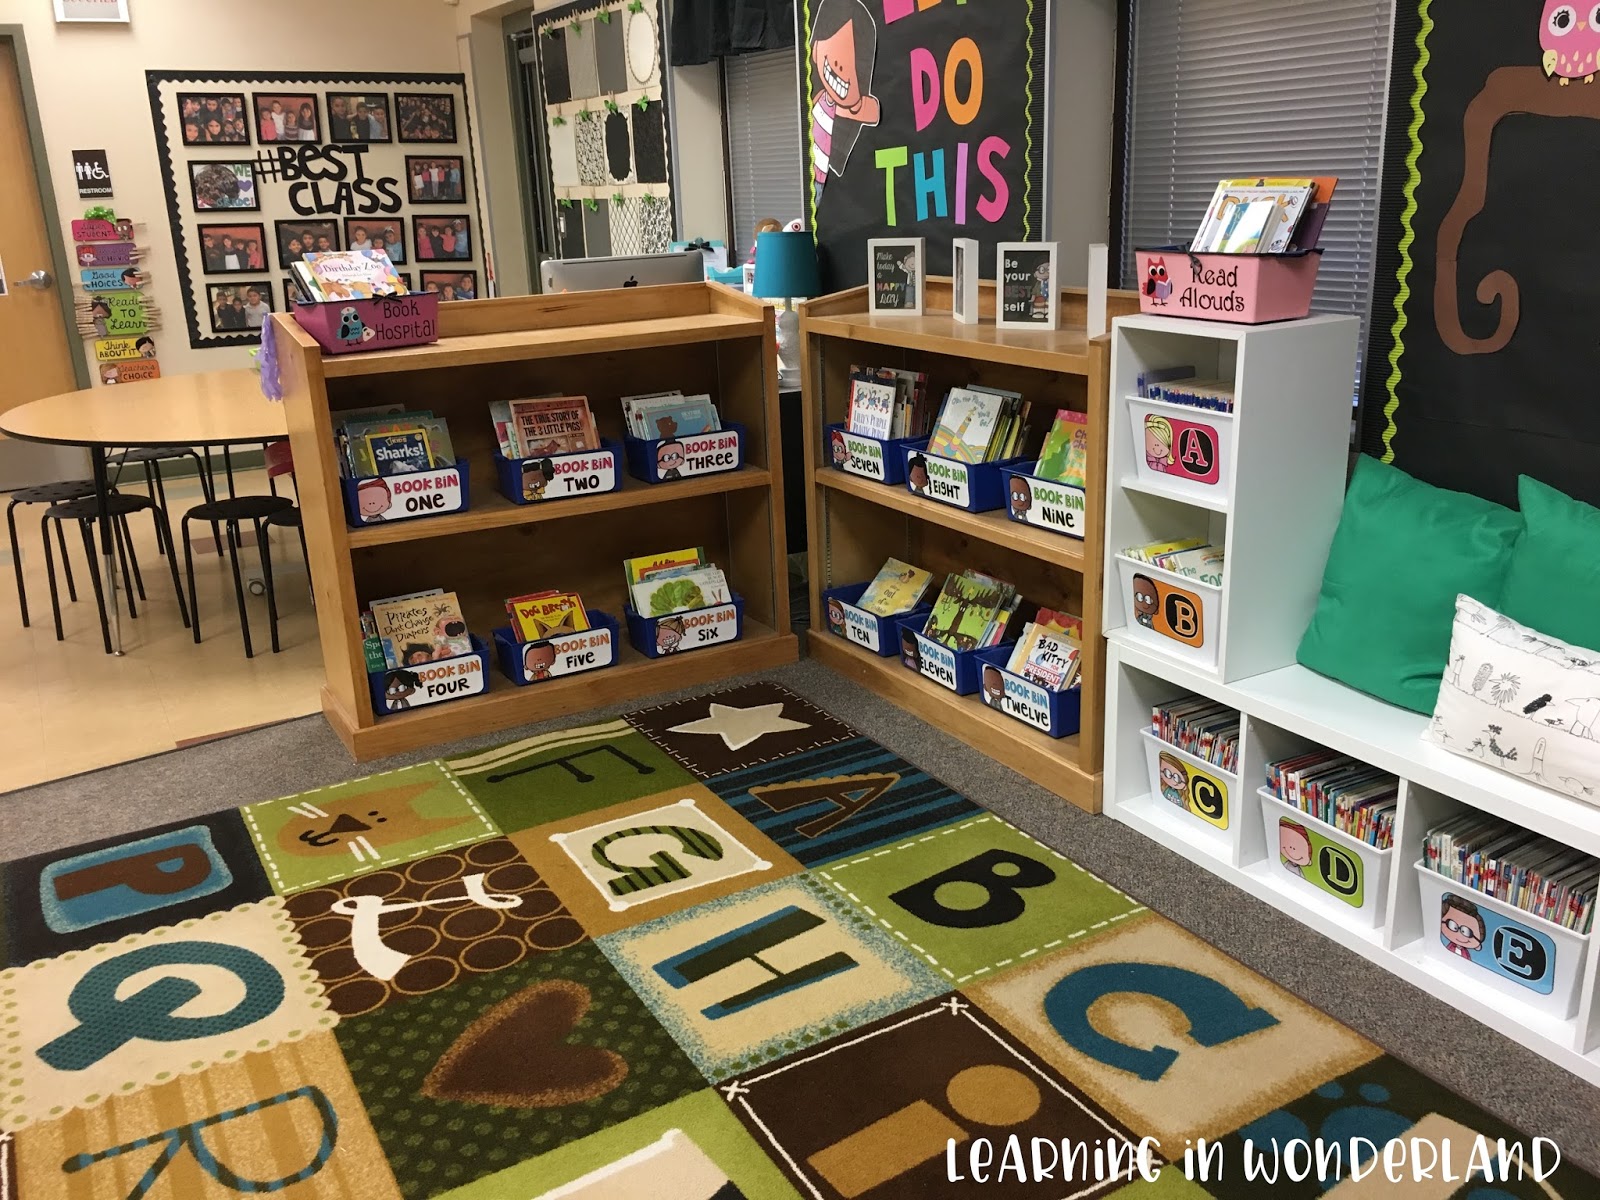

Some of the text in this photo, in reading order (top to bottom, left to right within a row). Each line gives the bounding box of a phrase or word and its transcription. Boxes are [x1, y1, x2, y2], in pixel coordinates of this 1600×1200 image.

[910, 37, 984, 132] DO
[875, 136, 1010, 226] THIS
[289, 177, 402, 216] CLASS
[876, 252, 892, 261] Make
[1004, 258, 1018, 268] Be
[92, 270, 116, 280] Good
[322, 262, 382, 273] Birthday Zoo
[876, 262, 895, 272] today
[1190, 262, 1238, 288] Read
[1004, 272, 1031, 282] your
[876, 282, 906, 292] HAPPY
[1004, 286, 1032, 298] BEST
[880, 294, 900, 307] DAY
[1004, 302, 1025, 312] self
[1180, 287, 1245, 312] Alouds
[120, 309, 136, 318] TO
[383, 300, 420, 318] Book
[110, 318, 147, 330] Learn
[100, 348, 136, 358] ABOUT IT
[104, 342, 130, 350] Think
[521, 410, 579, 426] THE TRUE STORY OF
[524, 421, 583, 437] THE 3 LITTLE PIGS!
[376, 442, 424, 460] Sharks!
[685, 440, 716, 454] BOOK
[848, 440, 868, 455] BOOK
[1182, 428, 1208, 466] A
[554, 460, 589, 475] BOOK
[928, 462, 950, 478] BOOK
[394, 478, 432, 495] BOOK
[564, 474, 600, 493] TWO
[1034, 486, 1064, 504] BOOK
[1180, 567, 1196, 576] The
[404, 616, 434, 629] Change
[684, 614, 716, 630] BOOK
[845, 610, 864, 626] BOOK
[1174, 600, 1196, 638] B
[396, 626, 429, 642] Diapers
[554, 638, 588, 655] BOOK
[919, 642, 939, 660] BOOK
[1038, 640, 1058, 652] BAD
[369, 652, 382, 660] the
[1041, 651, 1068, 668] KITTY
[419, 666, 455, 682] BOOK
[1024, 664, 1060, 684] PRESIDENT
[427, 678, 470, 698] FOUR
[1005, 678, 1030, 698] BOOK
[1194, 780, 1216, 814] C
[748, 773, 899, 840] A
[590, 824, 724, 896] G
[1326, 846, 1358, 888] D
[53, 843, 213, 899] P
[888, 847, 1056, 930] B
[1498, 928, 1533, 978] E
[653, 905, 859, 1021] H
[35, 940, 286, 1072] Q
[1043, 961, 1282, 1082] C
[61, 1085, 338, 1200] R
